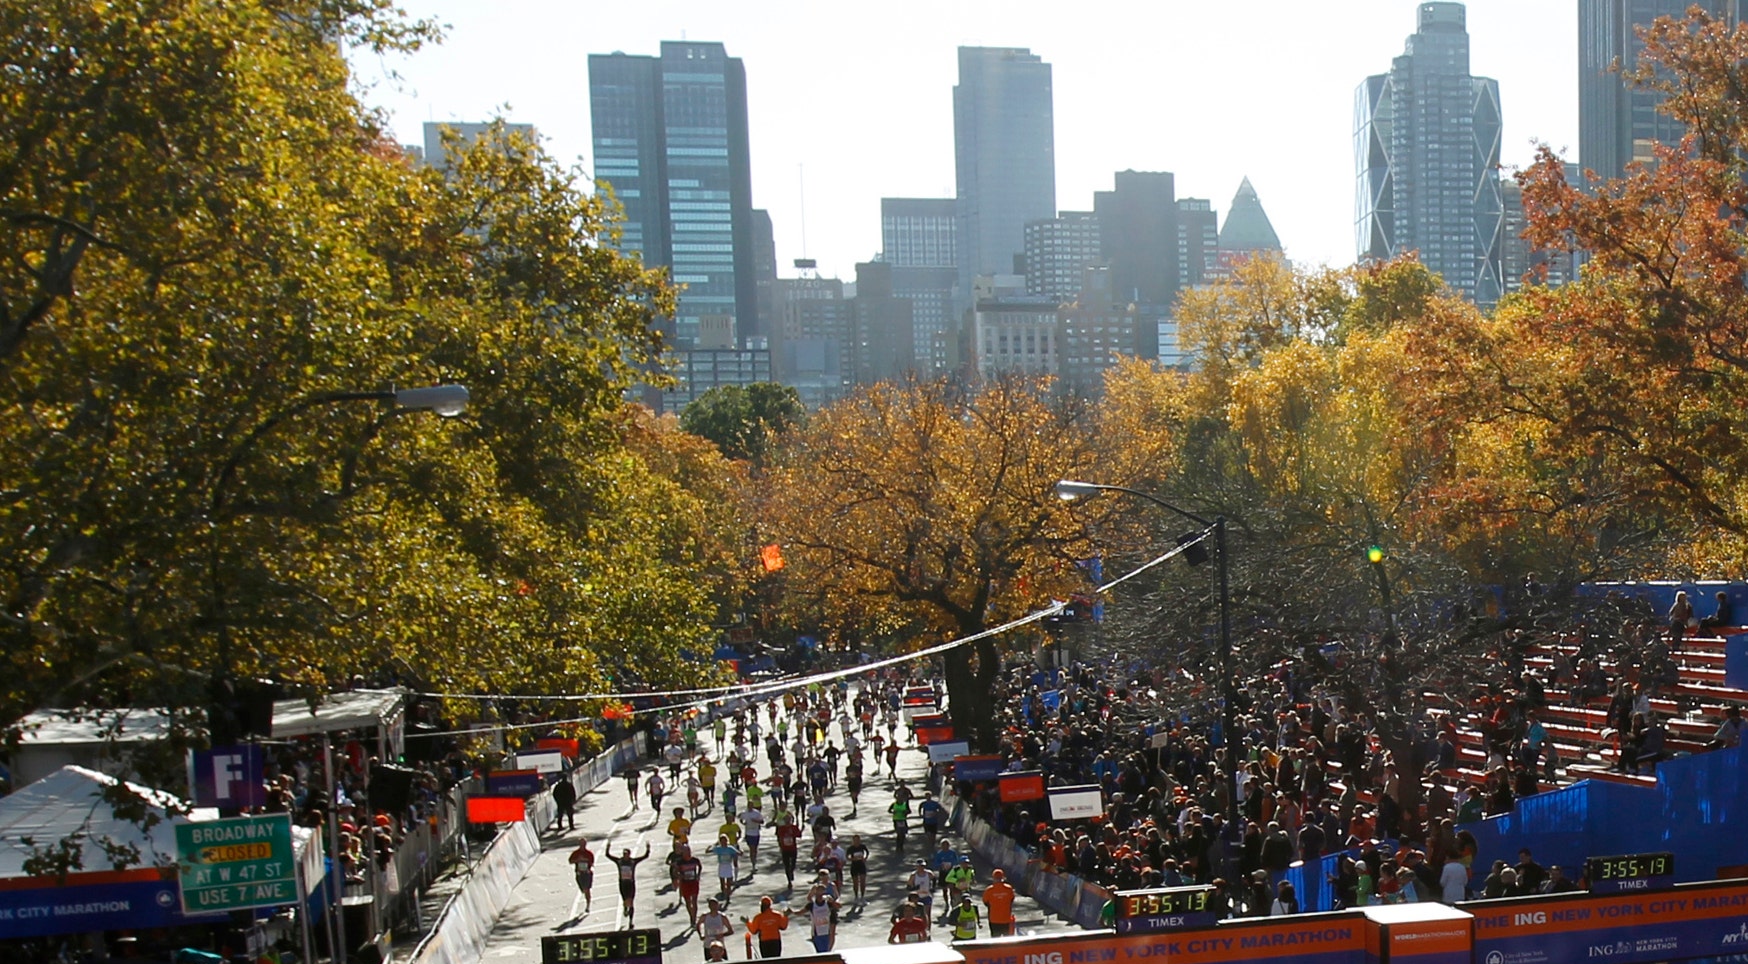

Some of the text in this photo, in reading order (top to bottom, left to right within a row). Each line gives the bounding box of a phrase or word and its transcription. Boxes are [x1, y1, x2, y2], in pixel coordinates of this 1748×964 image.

[192, 823, 275, 843] BROADWAY
[207, 846, 267, 862] CLOSED
[197, 862, 283, 884] AT W 47 ST
[200, 882, 284, 906] USE 7 AVE
[1617, 880, 1648, 890] TIMEX
[17, 906, 49, 919] CITY
[54, 901, 130, 916] MARATHON
[1476, 915, 1510, 929] THE
[1514, 911, 1546, 926] ING
[1552, 908, 1592, 922] NEW
[1597, 903, 1644, 919] YORK
[1650, 898, 1688, 914] CITY
[1148, 916, 1185, 928] TIMEX
[1070, 945, 1117, 963] NEW
[1125, 941, 1181, 958] YORK
[1187, 934, 1232, 952] CITY
[1240, 927, 1352, 949] MARATHON
[1588, 945, 1614, 957] ING
[1636, 942, 1677, 952] MARATHON
